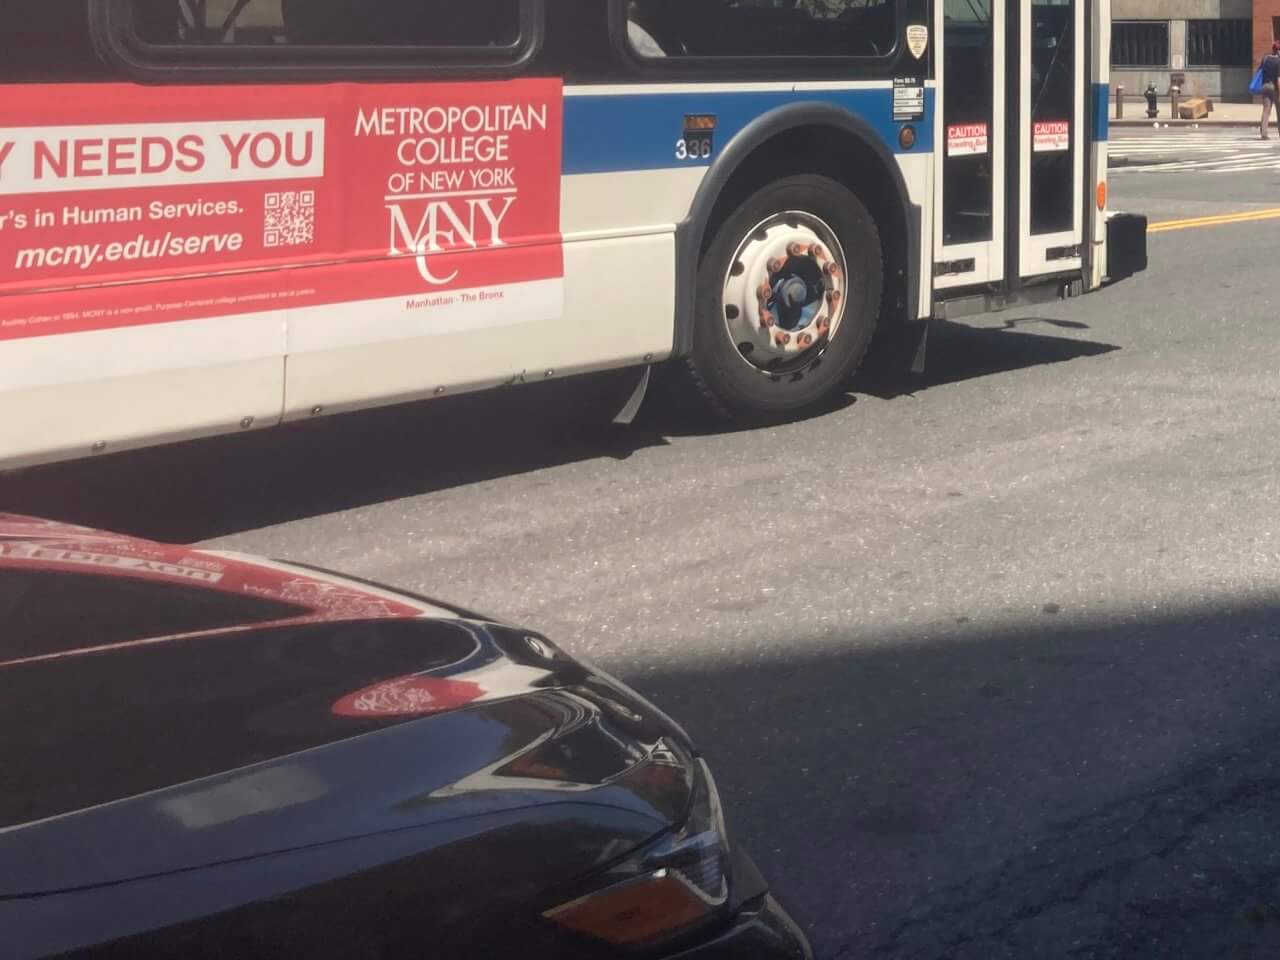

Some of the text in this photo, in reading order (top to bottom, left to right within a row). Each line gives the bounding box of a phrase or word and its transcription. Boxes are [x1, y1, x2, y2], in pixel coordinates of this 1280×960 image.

[354, 103, 547, 137] METROPOLITAN
[948, 124, 987, 138] CAUTION
[1034, 123, 1068, 135] CAUTION
[33, 134, 205, 180] NEEDS
[220, 130, 314, 170] YOU
[397, 135, 509, 166] COLLEGE
[675, 138, 711, 160] 336
[387, 167, 516, 193] OF NEW YORK
[35, 209, 55, 227] in
[62, 204, 142, 225] Human
[148, 198, 244, 219] Services.
[15, 231, 244, 270] mcny.edu/serve
[406, 291, 504, 309] Manhattan The Bronx
